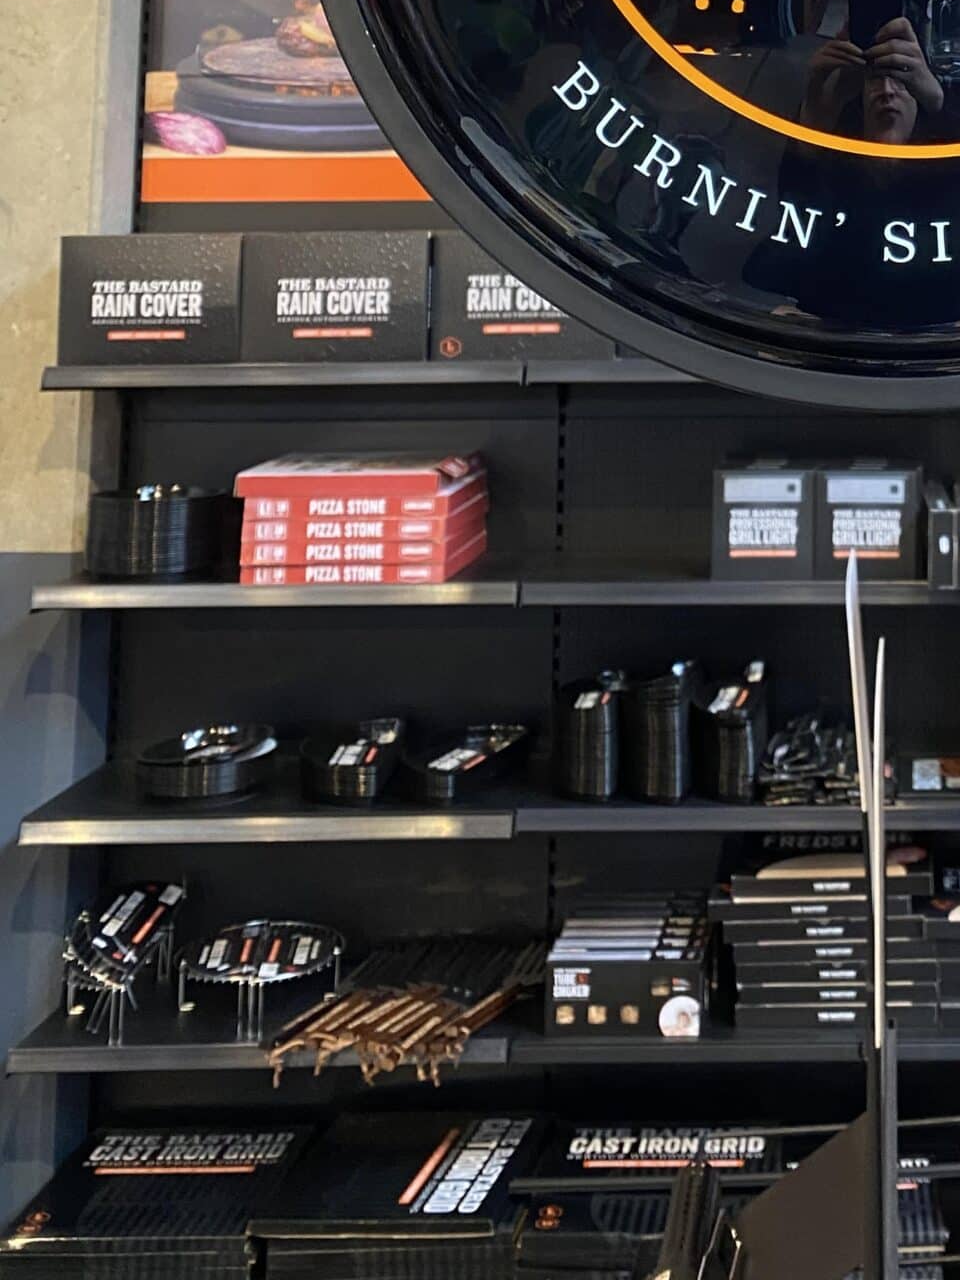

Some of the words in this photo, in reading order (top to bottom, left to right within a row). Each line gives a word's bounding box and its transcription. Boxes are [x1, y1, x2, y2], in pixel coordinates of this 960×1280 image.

[92, 280, 125, 294] THE
[128, 280, 203, 294] BASTARD
[277, 278, 311, 292] THE
[313, 277, 390, 292] BASTARD
[467, 274, 501, 289] THE
[91, 293, 137, 318] RAIN
[140, 293, 203, 318] COVER
[276, 291, 322, 316] RAIN
[326, 290, 390, 315] COVER
[466, 288, 512, 312] RAIN
[309, 499, 344, 514] PIZZA
[346, 499, 387, 514] STONE
[306, 523, 341, 538] PIZZA
[344, 523, 384, 538] STONE
[306, 545, 341, 560] PIZZA
[343, 545, 384, 560] STONE
[305, 567, 341, 582] PIZZA
[343, 567, 384, 582] STONE
[103, 1135, 162, 1146] THE
[569, 1137, 638, 1154] CAST
[637, 1137, 699, 1154] IRON
[703, 1136, 766, 1154] GRID
[89, 1145, 161, 1162] CAST
[157, 1144, 223, 1161] IRON
[223, 1144, 289, 1160] GRID
